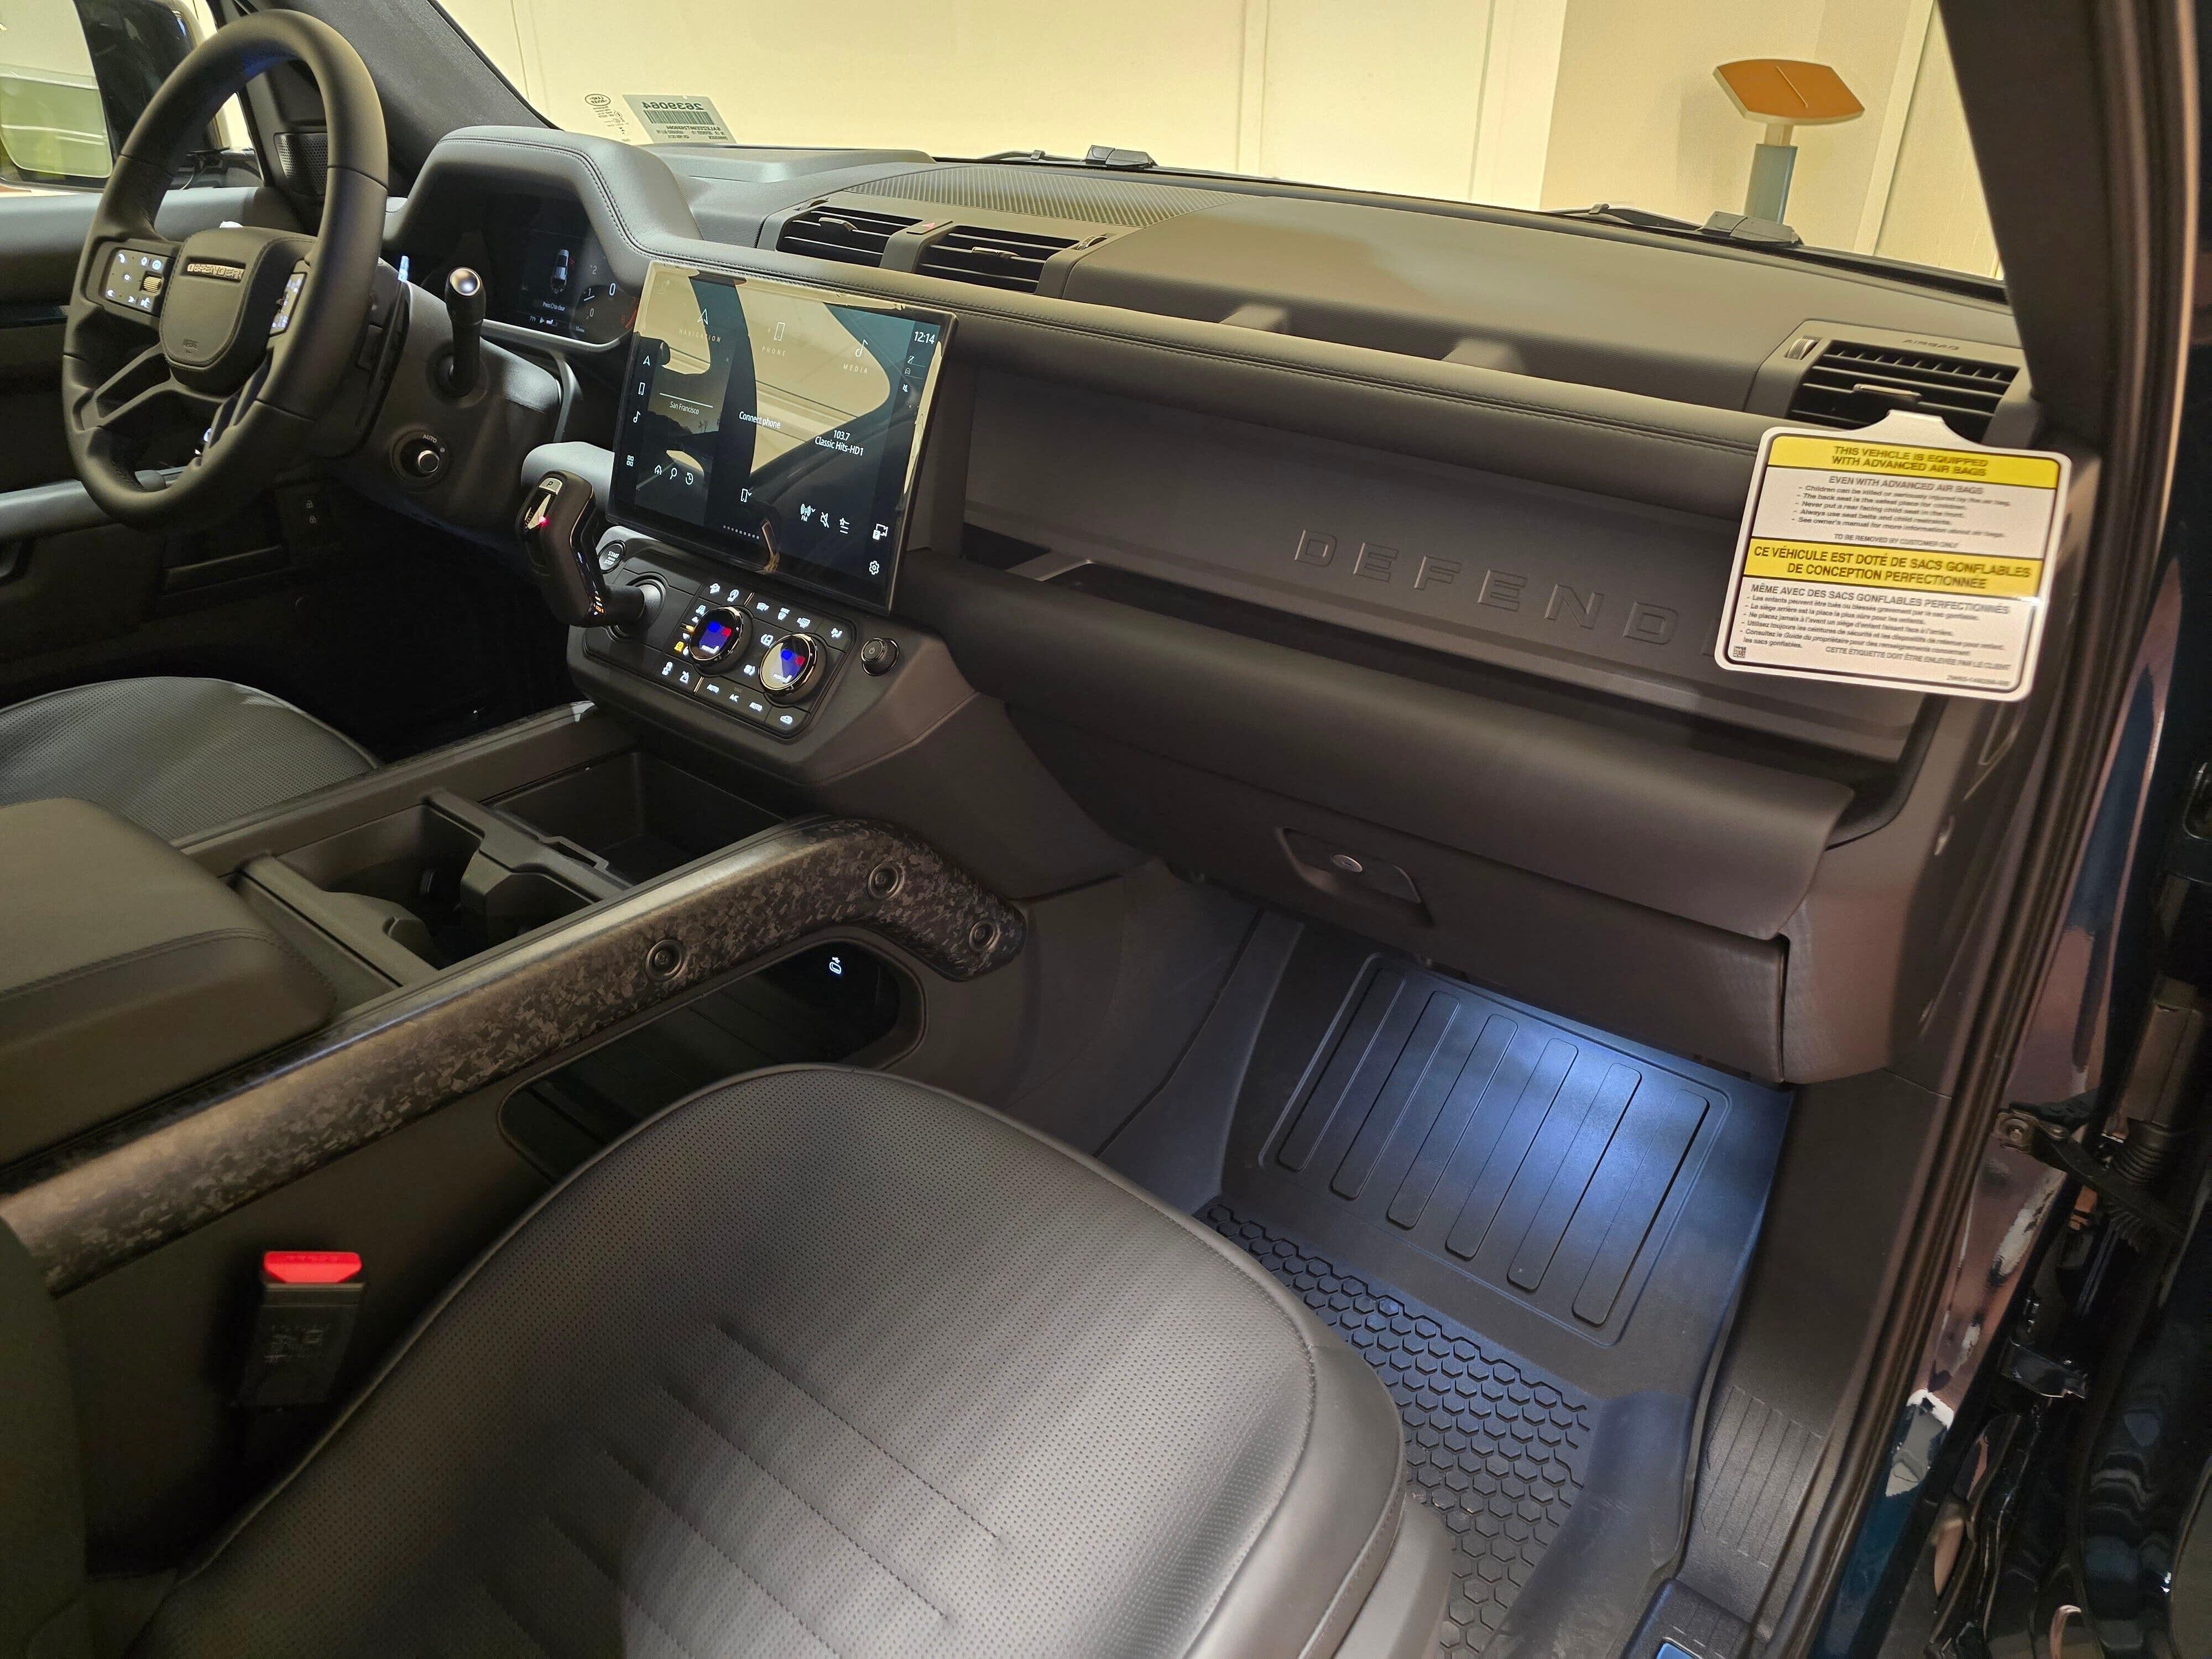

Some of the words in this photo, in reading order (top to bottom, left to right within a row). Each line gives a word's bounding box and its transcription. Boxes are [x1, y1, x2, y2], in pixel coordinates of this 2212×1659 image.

[187, 263, 244, 280] DEFENDER
[592, 265, 597, 275] 2
[609, 283, 616, 296] 0
[679, 328, 721, 342] NAVIGAION
[914, 331, 935, 344] 12:14
[762, 346, 786, 357] PHONE
[1902, 338, 1960, 351] AIRBAG
[843, 363, 867, 374] MEDIA
[670, 401, 678, 410] San
[679, 403, 699, 415] Francisco
[739, 411, 761, 424] Connect
[762, 417, 781, 429] phone
[422, 434, 437, 444] AUTO
[833, 430, 851, 441] 103.7
[815, 436, 836, 449] Classic
[836, 441, 864, 456] Hits-HD1
[1835, 446, 1859, 455] THIS
[1861, 449, 1910, 459] VEHICLE
[1928, 455, 1989, 466] EQUIPPED
[1832, 456, 1860, 465] WITH
[1863, 458, 1926, 471] ADVANCED
[1953, 466, 1987, 476] BAGS
[1881, 479, 1934, 491] ADVANCED
[1955, 486, 1983, 494] BAGS
[1754, 546, 1770, 556] CE
[1771, 545, 1828, 560] VÉHICULE
[1830, 552, 1854, 563] EST
[1856, 551, 1888, 566] DOTÉ
[1891, 557, 1907, 567] DE
[1910, 558, 1943, 570] SACS
[1945, 561, 2031, 577] GONFLABLES
[1787, 563, 1803, 573] DE
[1806, 564, 1882, 579] CONCEPTION
[1294, 529, 1716, 656] DEFEND
[1751, 582, 1779, 593] MÊME
[1781, 587, 1805, 596] AVEC
[1829, 591, 1854, 599] SACS
[1856, 592, 1922, 605] GONFLABLES
[1769, 640, 1802, 649] gonflables.
[707, 684, 719, 693] AUTO
[749, 702, 763, 712] AUTO
